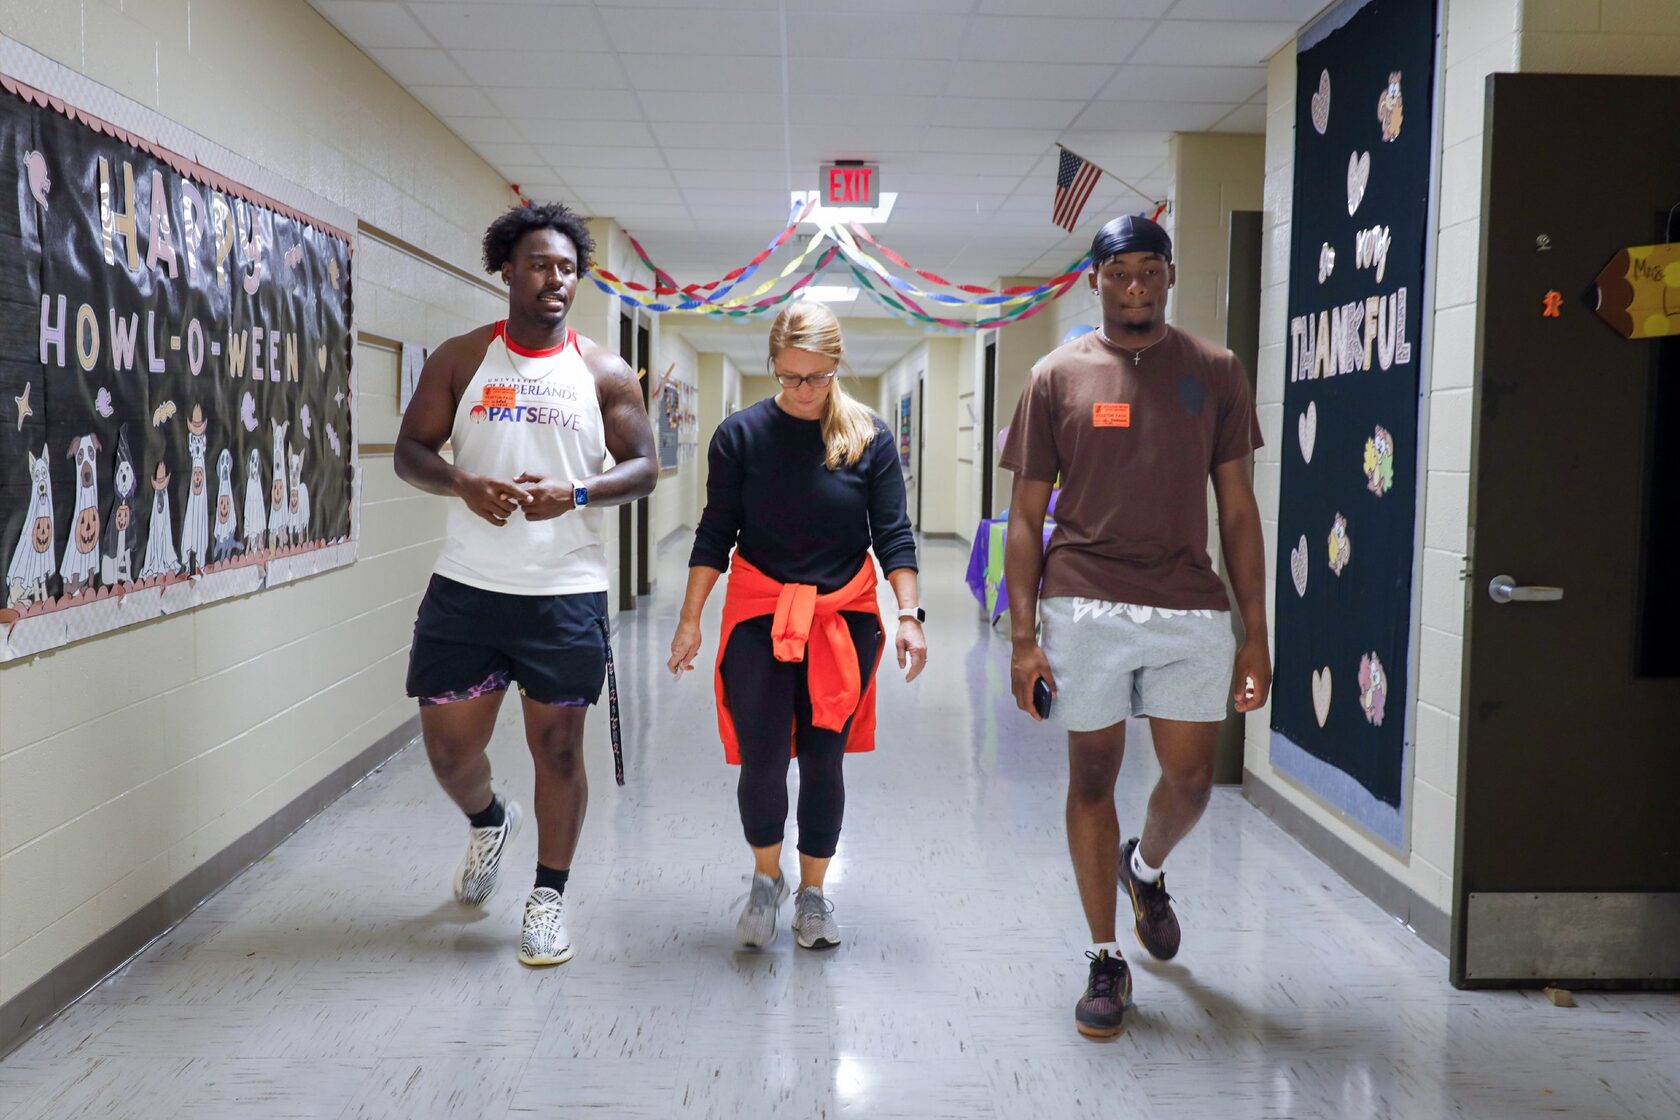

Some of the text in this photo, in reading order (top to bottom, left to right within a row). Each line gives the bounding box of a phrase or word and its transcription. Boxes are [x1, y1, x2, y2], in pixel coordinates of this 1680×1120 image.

[98, 155, 262, 295] HAPPY
[829, 168, 872, 204] EXIT
[39, 294, 299, 382] HOWL-O-WEEN
[1291, 287, 1411, 383] THANKFUL
[488, 406, 582, 431] PATSERVE
